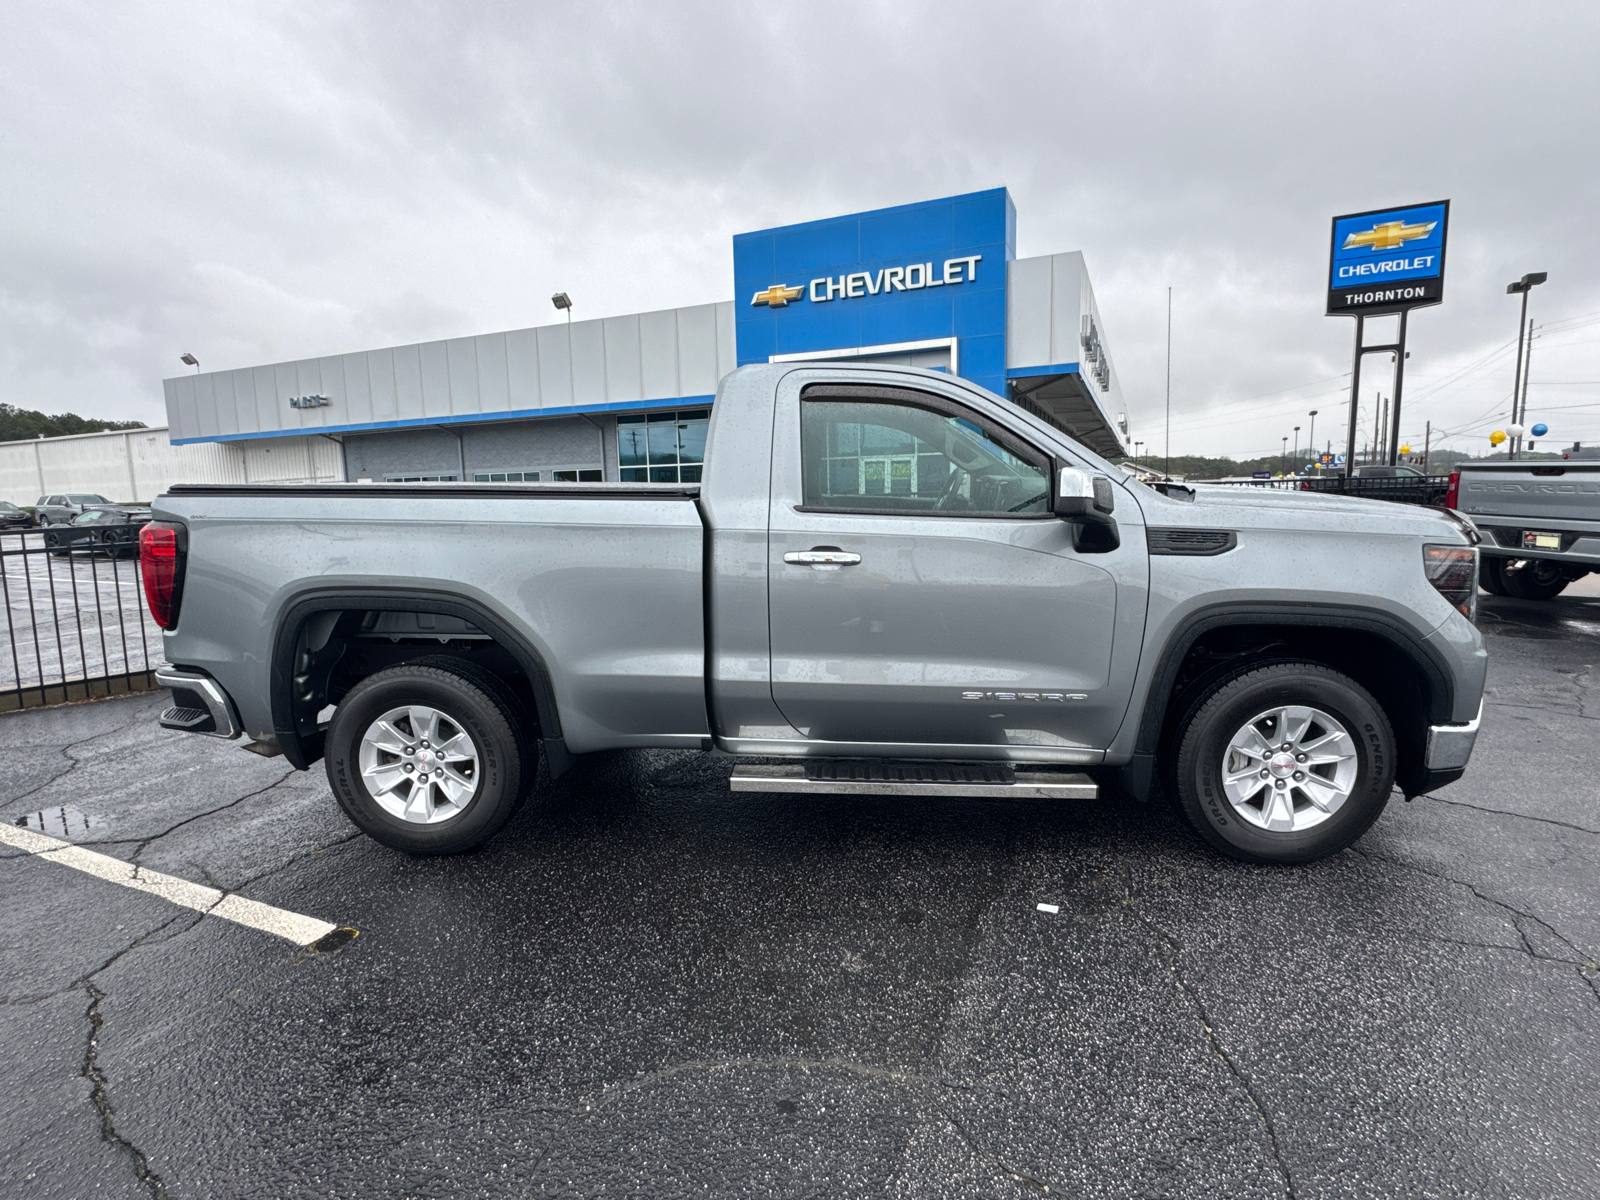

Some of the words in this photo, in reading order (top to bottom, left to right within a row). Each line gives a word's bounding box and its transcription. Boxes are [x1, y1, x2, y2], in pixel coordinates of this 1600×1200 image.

[810, 254, 982, 302] CHEVROLET
[1339, 255, 1435, 278] CHEVROLET
[1345, 286, 1425, 304] THORNTON
[1468, 482, 1600, 494] CHEVROL
[962, 691, 1088, 702] SIERRA
[1363, 723, 1384, 794] GENERAL
[336, 758, 373, 823] GENERAL
[1202, 754, 1228, 827] GRABBER
